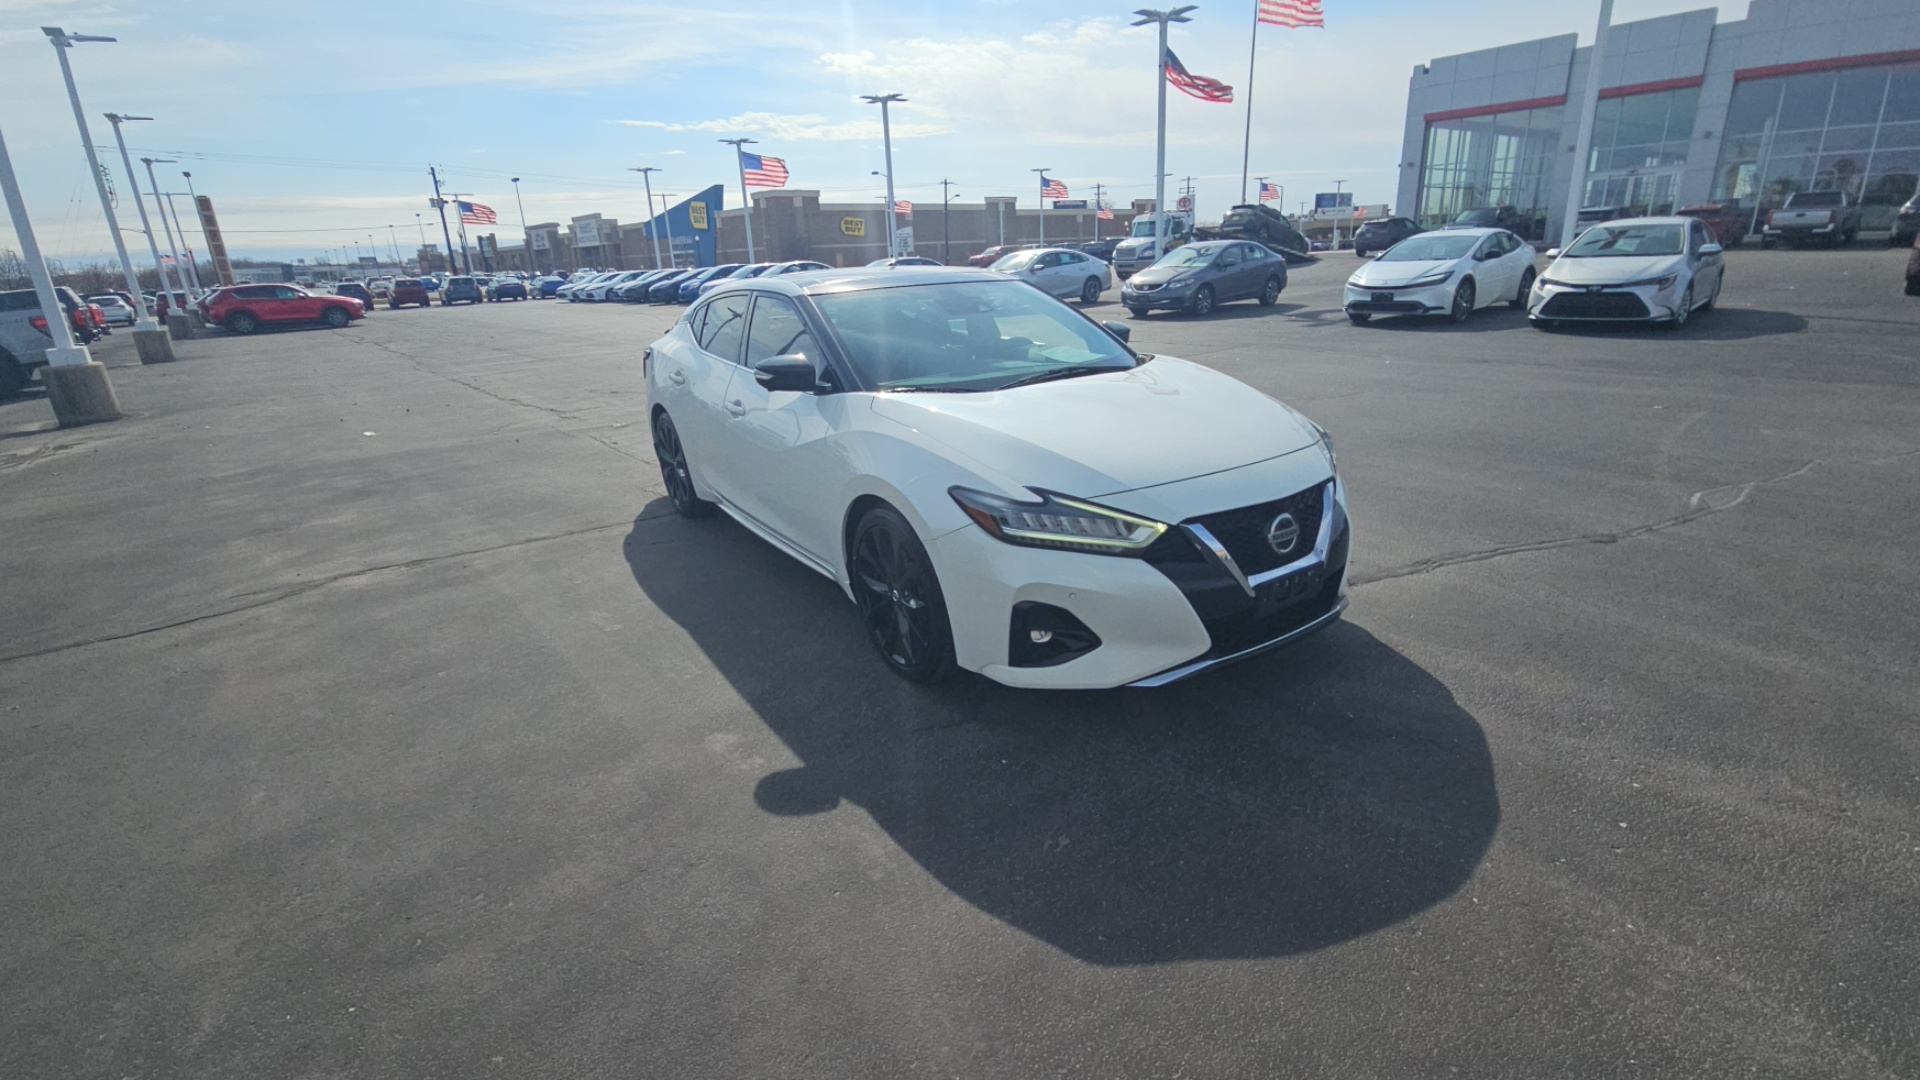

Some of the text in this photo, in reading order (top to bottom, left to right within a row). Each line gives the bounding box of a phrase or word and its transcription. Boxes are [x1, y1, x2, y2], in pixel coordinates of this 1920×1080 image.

[691, 206, 705, 215] BEST
[693, 215, 705, 225] BUY
[843, 219, 864, 227] BEST
[1272, 528, 1297, 541] NISSAN
